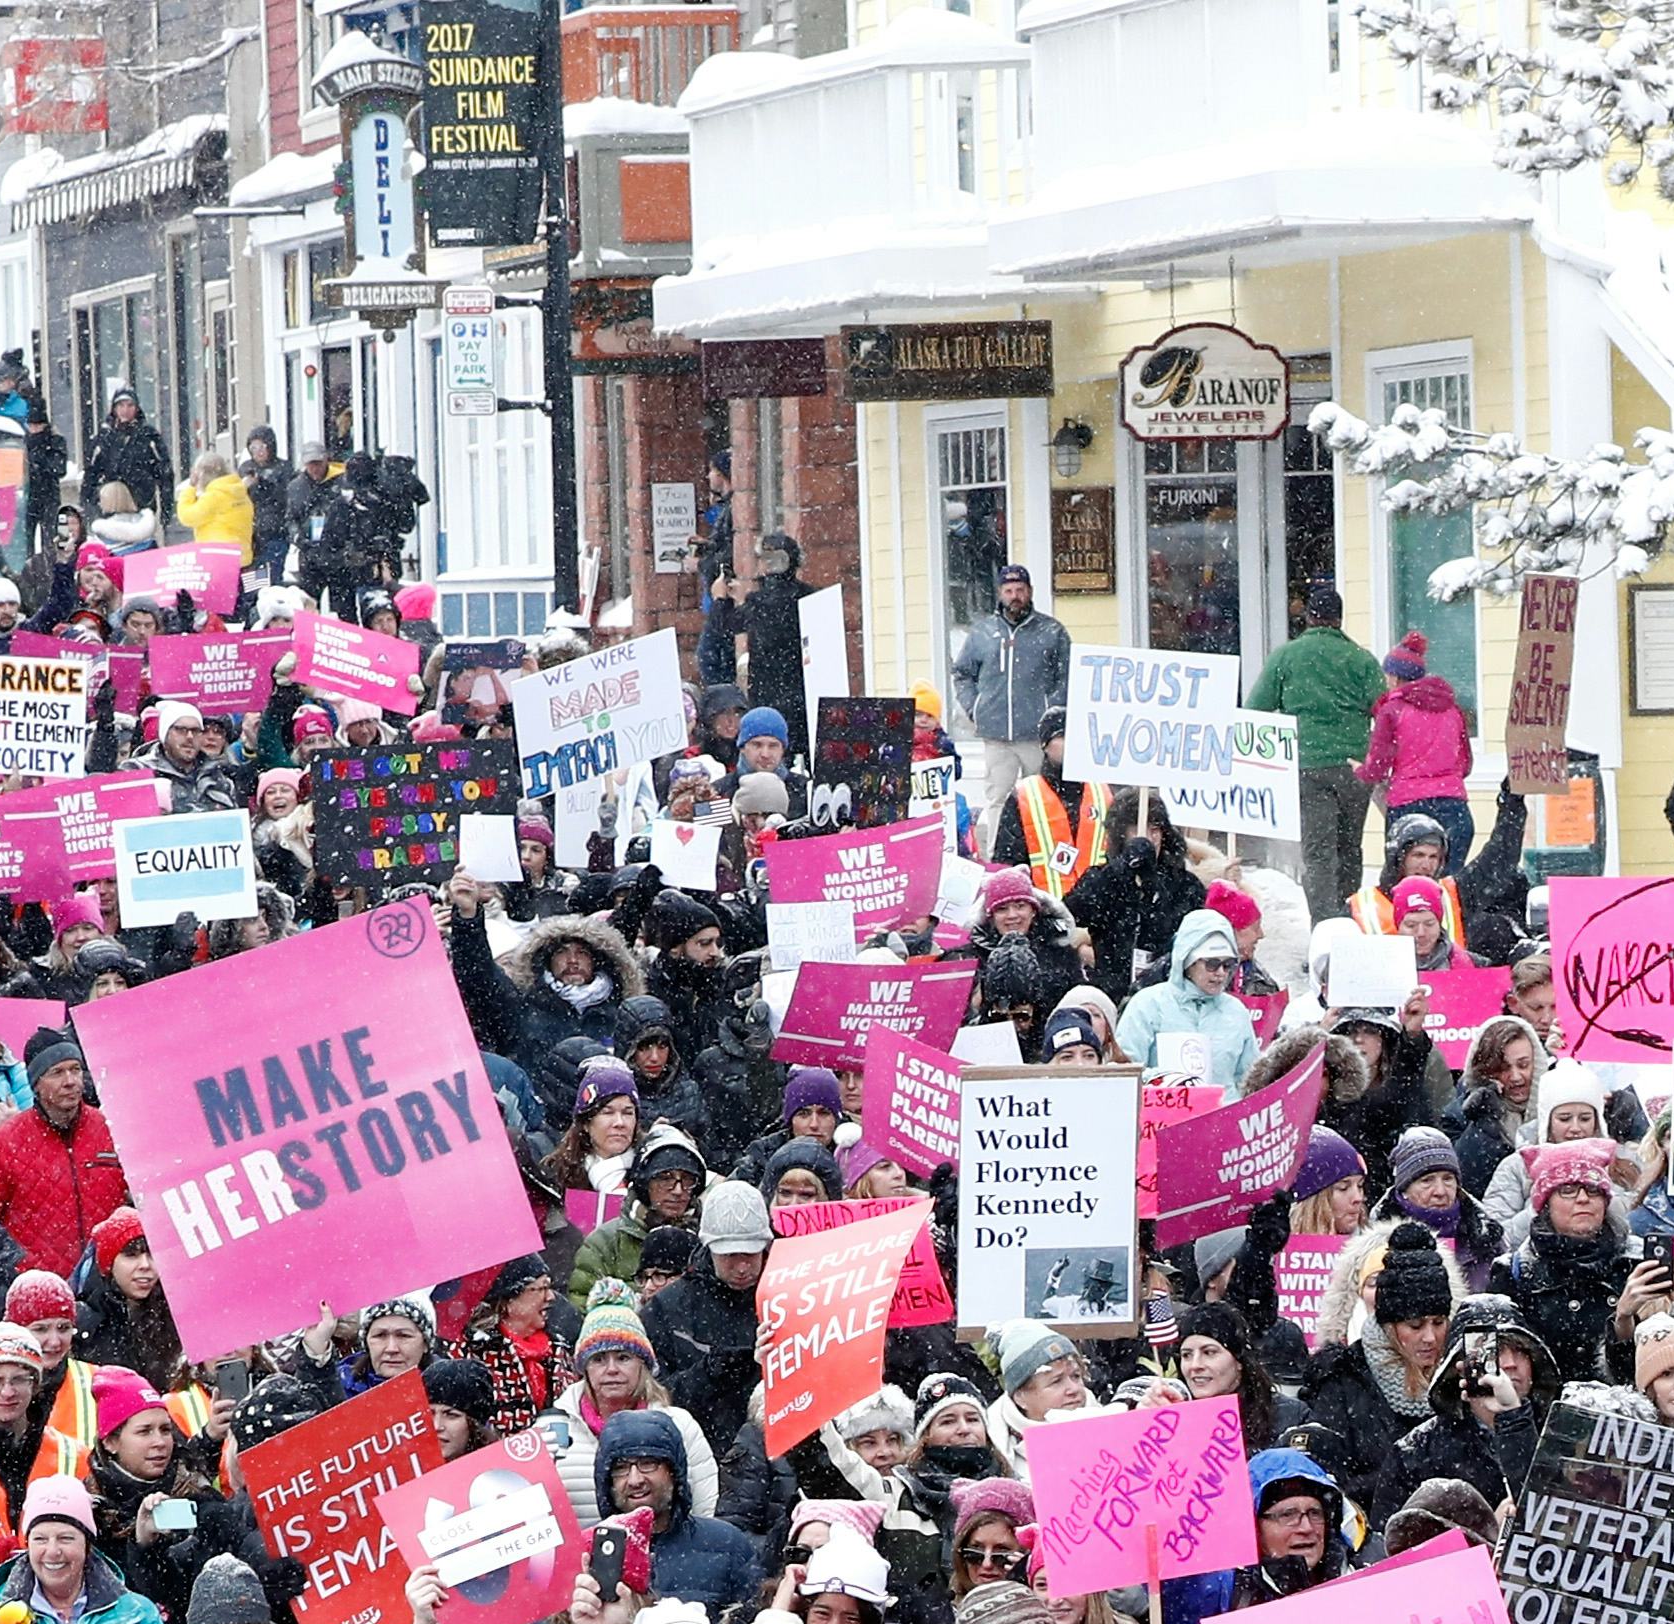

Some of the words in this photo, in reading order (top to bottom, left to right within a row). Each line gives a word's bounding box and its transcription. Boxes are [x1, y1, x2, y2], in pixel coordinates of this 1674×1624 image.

[428, 24, 474, 52] 2017
[334, 66, 371, 88] MAIN
[429, 55, 535, 87] SUNDANCE
[457, 91, 503, 119] FILM
[431, 126, 522, 153] FESTIVAL
[374, 118, 391, 257] DELI
[343, 285, 436, 305] DELICATESSEN
[458, 342, 481, 351] PAY
[463, 353, 478, 362] TO
[899, 338, 951, 370] ALASKA
[955, 337, 983, 368] FUR
[988, 334, 1047, 366] GALLERY
[453, 364, 487, 375] PARK
[1134, 345, 1282, 409] BARANOF
[1147, 411, 1264, 423] JEWELERS
[1157, 488, 1220, 506] FURKINI
[1521, 578, 1576, 633] NEVER
[543, 665, 574, 686] WE
[591, 644, 636, 671] WERE
[1528, 643, 1554, 685] BE
[1080, 654, 1209, 708] TRUST
[23, 702, 70, 720] MOST
[549, 671, 641, 727] MADE
[1513, 680, 1569, 728] SILENT
[14, 723, 85, 743] ELEMENT
[582, 713, 612, 731] TO
[523, 732, 617, 795] IMPEACH
[629, 714, 681, 756] YOU
[1087, 712, 1235, 774] WOMEN
[134, 845, 242, 873] EQUALITY
[194, 1027, 388, 1146] MAKE
[975, 1097, 1052, 1118] What
[975, 1127, 1069, 1151] Would
[161, 1071, 482, 1258] HERSTORY
[975, 1160, 1097, 1187] Florynce
[975, 1193, 1098, 1218] Kennedy
[975, 1226, 1027, 1249] Do?
[1094, 1409, 1180, 1549] FORWARD
[1165, 1409, 1240, 1560] BACKWARD
[1044, 1450, 1121, 1564] Marching
[429, 1518, 475, 1545] CLOSE
[496, 1538, 523, 1558] THE
[526, 1527, 554, 1548] GAP
